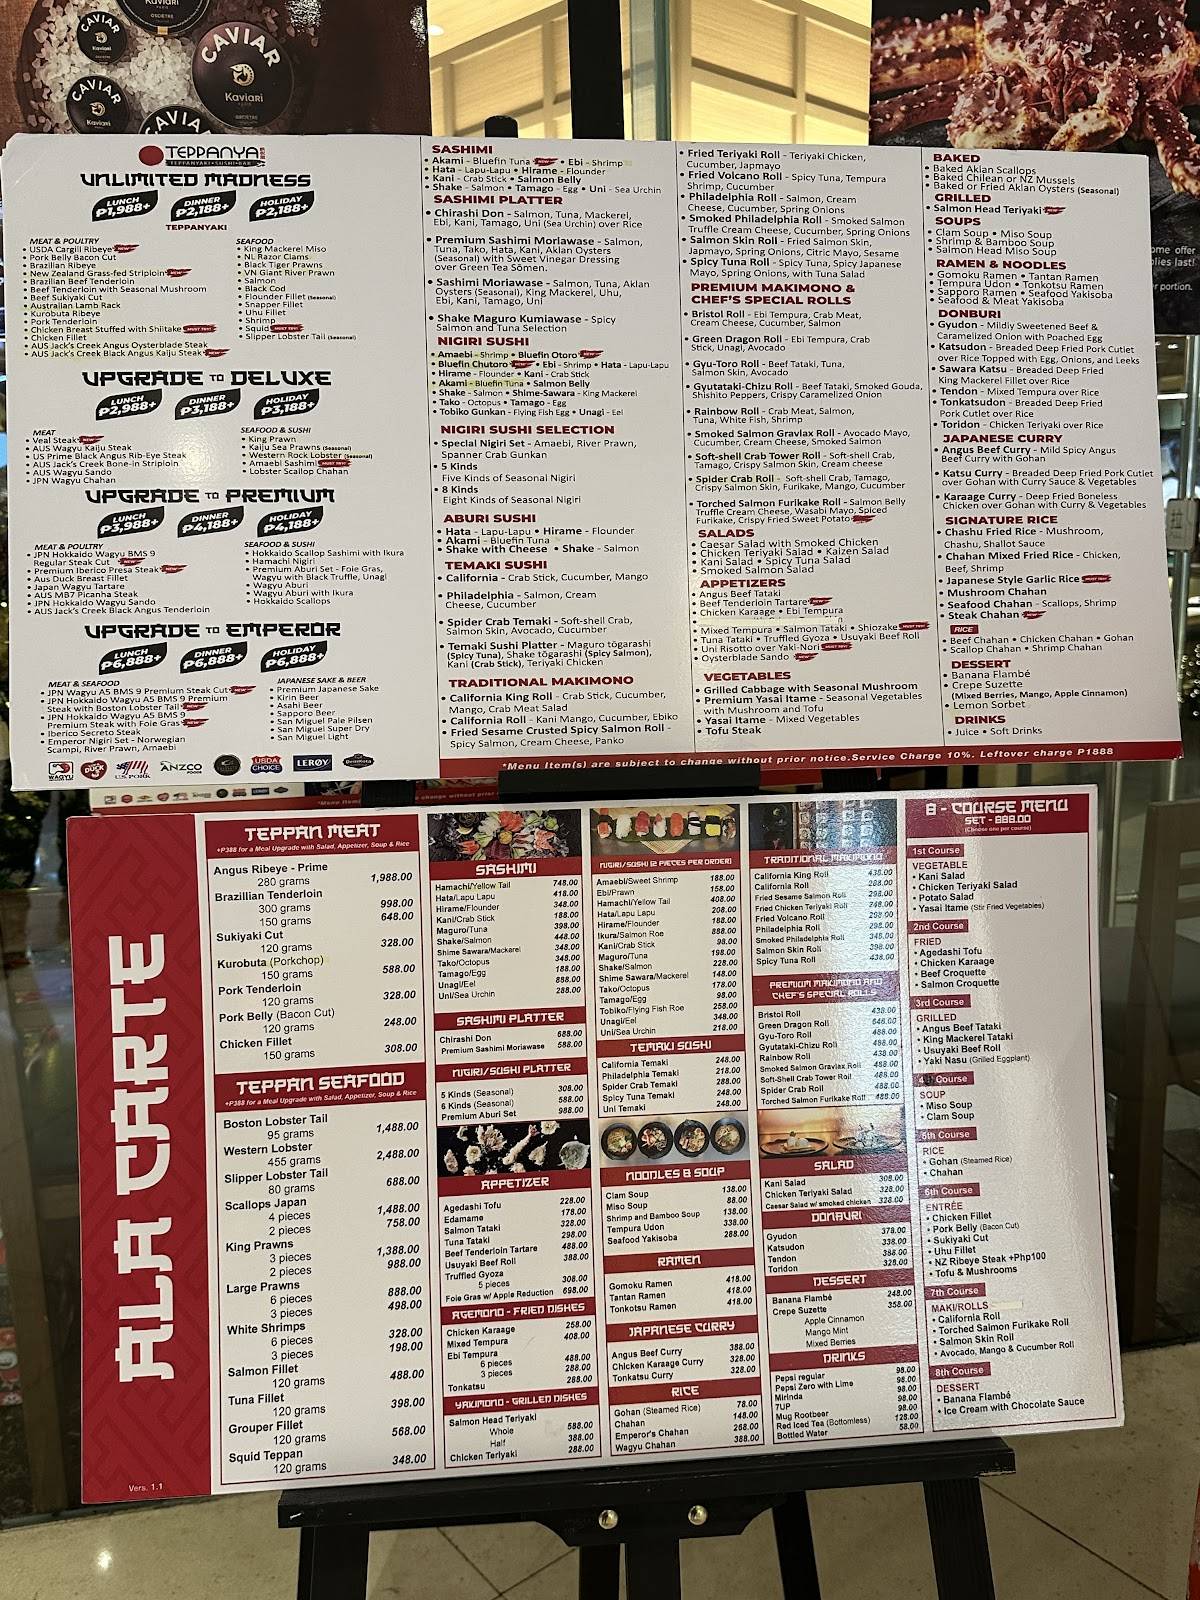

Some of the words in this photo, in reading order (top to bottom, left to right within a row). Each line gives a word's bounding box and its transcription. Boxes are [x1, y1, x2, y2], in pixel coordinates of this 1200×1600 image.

[79, 13, 121, 35] CAVIAR
[201, 26, 282, 68] CAVIAR
[71, 79, 122, 106] CAVIAR
[165, 146, 259, 159] TEPPANYA
[432, 145, 492, 154] SASHIMI
[933, 153, 981, 163] BAKED
[80, 172, 198, 187] UNLIMITED
[204, 173, 311, 187] MADNESS
[105, 196, 140, 207] LUNCH
[183, 196, 221, 207] DINNER
[259, 195, 303, 206] HOLIDAY
[434, 195, 495, 204] SASHIMI
[499, 195, 563, 205] PLATTER
[934, 193, 991, 203] GRILLED
[935, 216, 981, 226] SOUPS
[1175, 245, 1196, 255] offer
[936, 259, 985, 268] RAMEN
[1002, 260, 1066, 270] NOODLES
[1174, 257, 1195, 267] last!
[937, 270, 980, 279] Gomoku
[983, 271, 1017, 280] Ramen
[691, 283, 757, 292] PREMIUM
[761, 283, 842, 293] MAKIMONO
[1160, 282, 1193, 292] portion.
[691, 295, 741, 304] CHEF'S
[745, 296, 804, 305] SPECIAL
[807, 296, 851, 305] ROLLS
[938, 309, 1001, 319] DONBURI
[438, 337, 482, 346] NIGIRI
[486, 337, 529, 346] SUSHI
[82, 370, 203, 387] UPGRADE
[209, 374, 224, 382] TO
[230, 371, 331, 386] DELUXE
[441, 425, 485, 434] NIGIRI
[489, 425, 532, 434] SUSHI
[536, 425, 614, 434] SELECTION
[943, 434, 1014, 443] JAPANESE
[1017, 434, 1063, 443] CURRY
[85, 488, 200, 504] UPGRADE
[225, 488, 335, 503] PREMIUM
[443, 514, 489, 523] ABURI
[493, 514, 536, 523] SUSHI
[945, 516, 1023, 525] SIGNATURE
[1027, 515, 1058, 524] RICE
[698, 529, 755, 538] SALADS
[700, 540, 735, 549] Caesar
[738, 539, 765, 548] Salad
[768, 539, 791, 548] with
[794, 538, 835, 547] Smoked
[838, 537, 879, 547] Chicken
[444, 561, 501, 570] TEMAKI
[504, 560, 547, 570] SUSHI
[700, 578, 786, 588] APPETIZERS
[948, 611, 977, 620] Steak
[980, 610, 1020, 619] Chahan
[84, 623, 200, 639] UPGRADE
[205, 626, 220, 634] TO
[226, 622, 341, 637] EMPEROR
[951, 659, 1011, 669] DESSERT
[703, 671, 791, 681] VEGETABLES
[448, 678, 548, 688] TRADITIONAL
[551, 676, 634, 686] MAKIMONO
[955, 715, 1006, 724] DRINKS
[705, 726, 729, 735] Tofu
[732, 726, 762, 735] Steak
[980, 748, 1030, 759] Leftover
[1033, 747, 1073, 760] charge
[1077, 746, 1114, 757] P1888
[244, 825, 323, 841] TEPPAN
[327, 823, 381, 838] MEAT
[912, 846, 927, 855] 1st
[928, 845, 960, 855] Course
[213, 864, 249, 876] Angus
[252, 864, 288, 875] Ribeye
[298, 862, 328, 872] Prime
[476, 862, 536, 875] SASHIMI
[257, 877, 276, 887] 280
[278, 876, 310, 888] grams
[371, 872, 413, 883] 1,988.00
[918, 883, 954, 891] Chicken
[956, 881, 991, 892] Teriyaki
[993, 880, 1018, 889] Salad
[215, 891, 264, 902] Brazillian
[267, 889, 322, 900] Tenderloin
[380, 898, 414, 908] 998.00
[258, 904, 278, 914] 300
[280, 904, 311, 915] grams
[913, 922, 931, 932] 2nd
[933, 921, 964, 931] Course
[216, 931, 262, 943] Sukiyaki
[264, 930, 284, 940] Cut
[380, 937, 414, 947] 328.00
[217, 958, 267, 969] Kurobuta
[270, 955, 324, 969] (Porkchop)
[920, 958, 956, 967] Chicken
[958, 958, 995, 967] Karaage
[382, 964, 416, 974] 588.00
[219, 1039, 263, 1049] Chicken
[266, 1037, 292, 1047] Fillet
[384, 1043, 418, 1053] 308.00
[107, 933, 171, 1196] CARTE
[236, 1077, 314, 1095] TEPPAN
[319, 1072, 404, 1090] SEAFOOD
[223, 1117, 262, 1129] Boston
[265, 1116, 307, 1126] Lobster
[309, 1113, 328, 1124] Tail
[376, 1121, 419, 1134] 1,488.00
[267, 1130, 280, 1140] 95
[282, 1128, 314, 1140] grams
[814, 1160, 854, 1171] SALAD
[481, 1177, 549, 1190] APPETIZER
[226, 1242, 251, 1253] King
[254, 1241, 294, 1250] Prawns
[657, 1255, 701, 1267] RAMEN
[813, 1274, 867, 1286] DESSERT
[113, 1216, 176, 1383] ALA
[227, 1324, 258, 1335] White
[261, 1322, 306, 1333] Shrimps
[628, 1323, 693, 1337] JAPANESE
[694, 1321, 735, 1332] CURRY
[823, 1351, 865, 1363] DRINKS
[935, 1367, 951, 1377] 8th
[953, 1365, 984, 1375] Course
[671, 1386, 699, 1397] RICE
[936, 1382, 980, 1393] DESSERT
[944, 1407, 957, 1415] Ice
[959, 1404, 988, 1415] Cream
[990, 1402, 1009, 1414] with
[1011, 1398, 1056, 1410] Chocolate
[1057, 1398, 1085, 1407] Sauce
[229, 1451, 260, 1464] Squid
[263, 1450, 303, 1462] Teppan
[392, 1453, 427, 1465] 348.00
